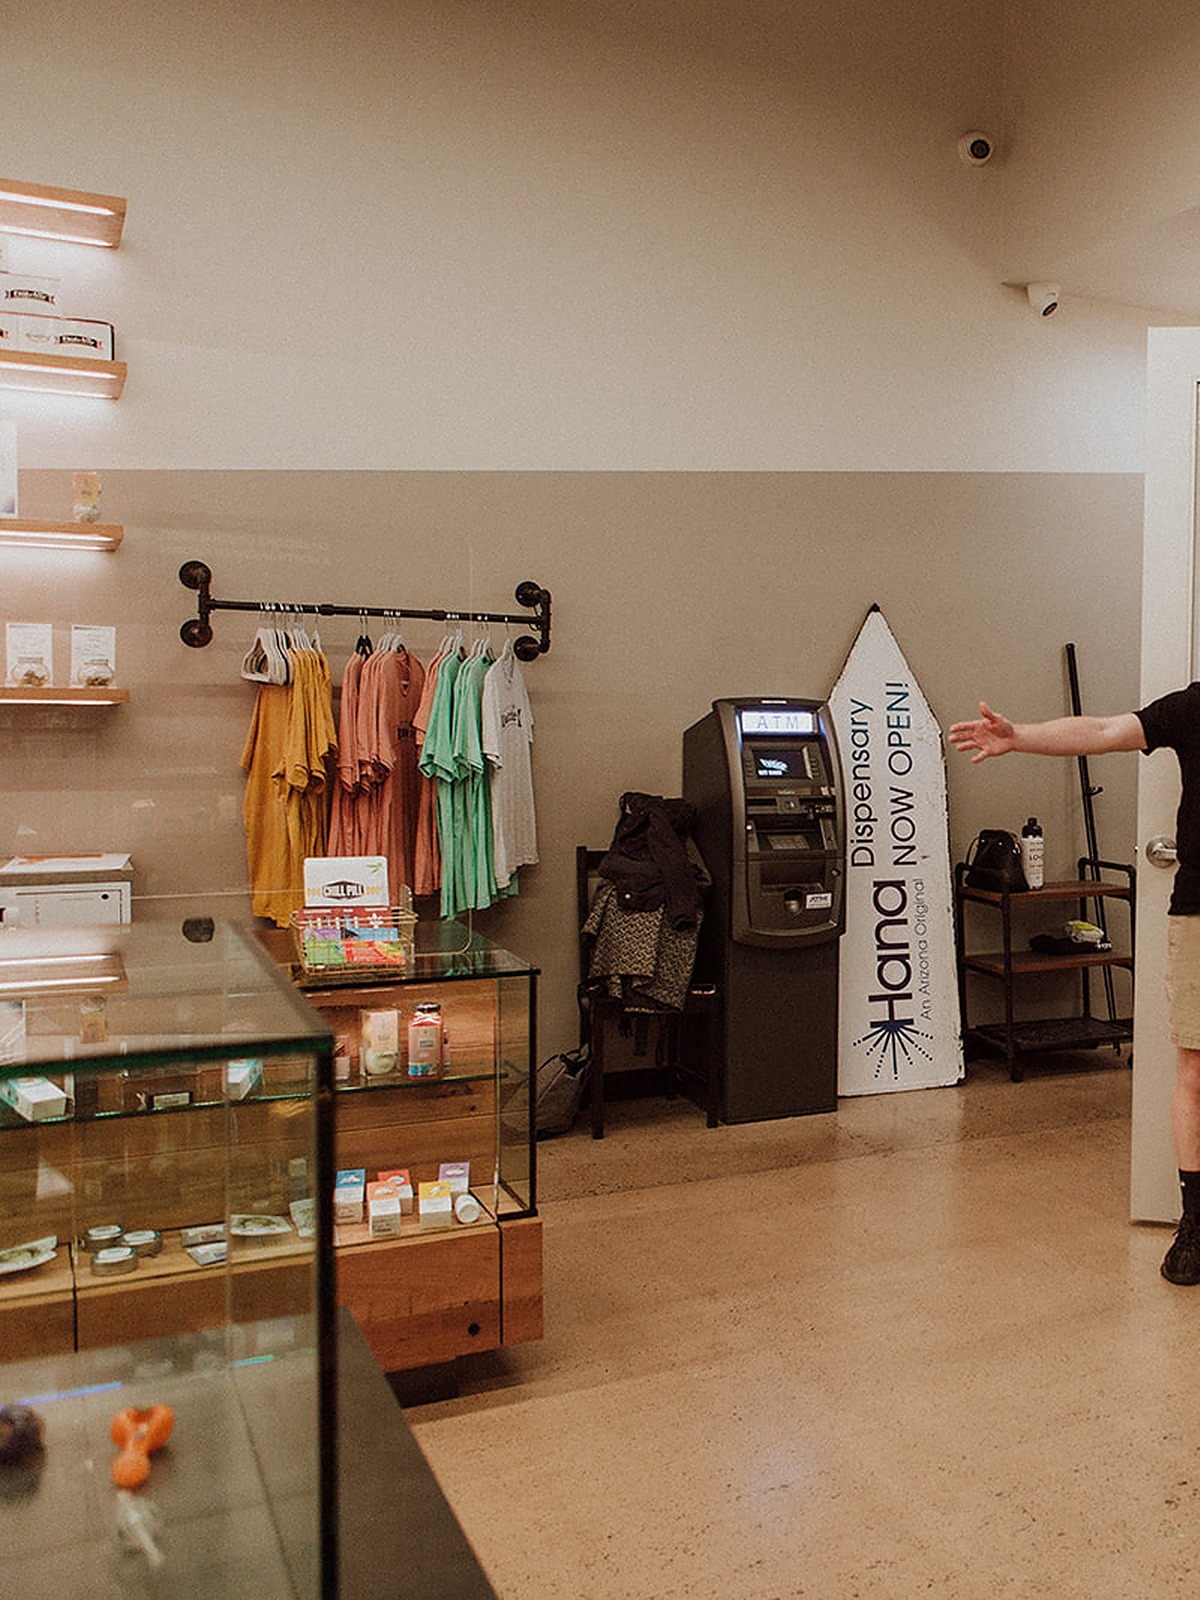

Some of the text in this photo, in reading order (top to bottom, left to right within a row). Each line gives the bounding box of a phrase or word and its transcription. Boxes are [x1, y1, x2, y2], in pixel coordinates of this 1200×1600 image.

[756, 715, 800, 730] ATM
[850, 698, 878, 867] Dispensary
[885, 682, 917, 866] NOW OPEN!
[868, 880, 914, 1028] Hana
[913, 879, 932, 1020] An Arizona Original
